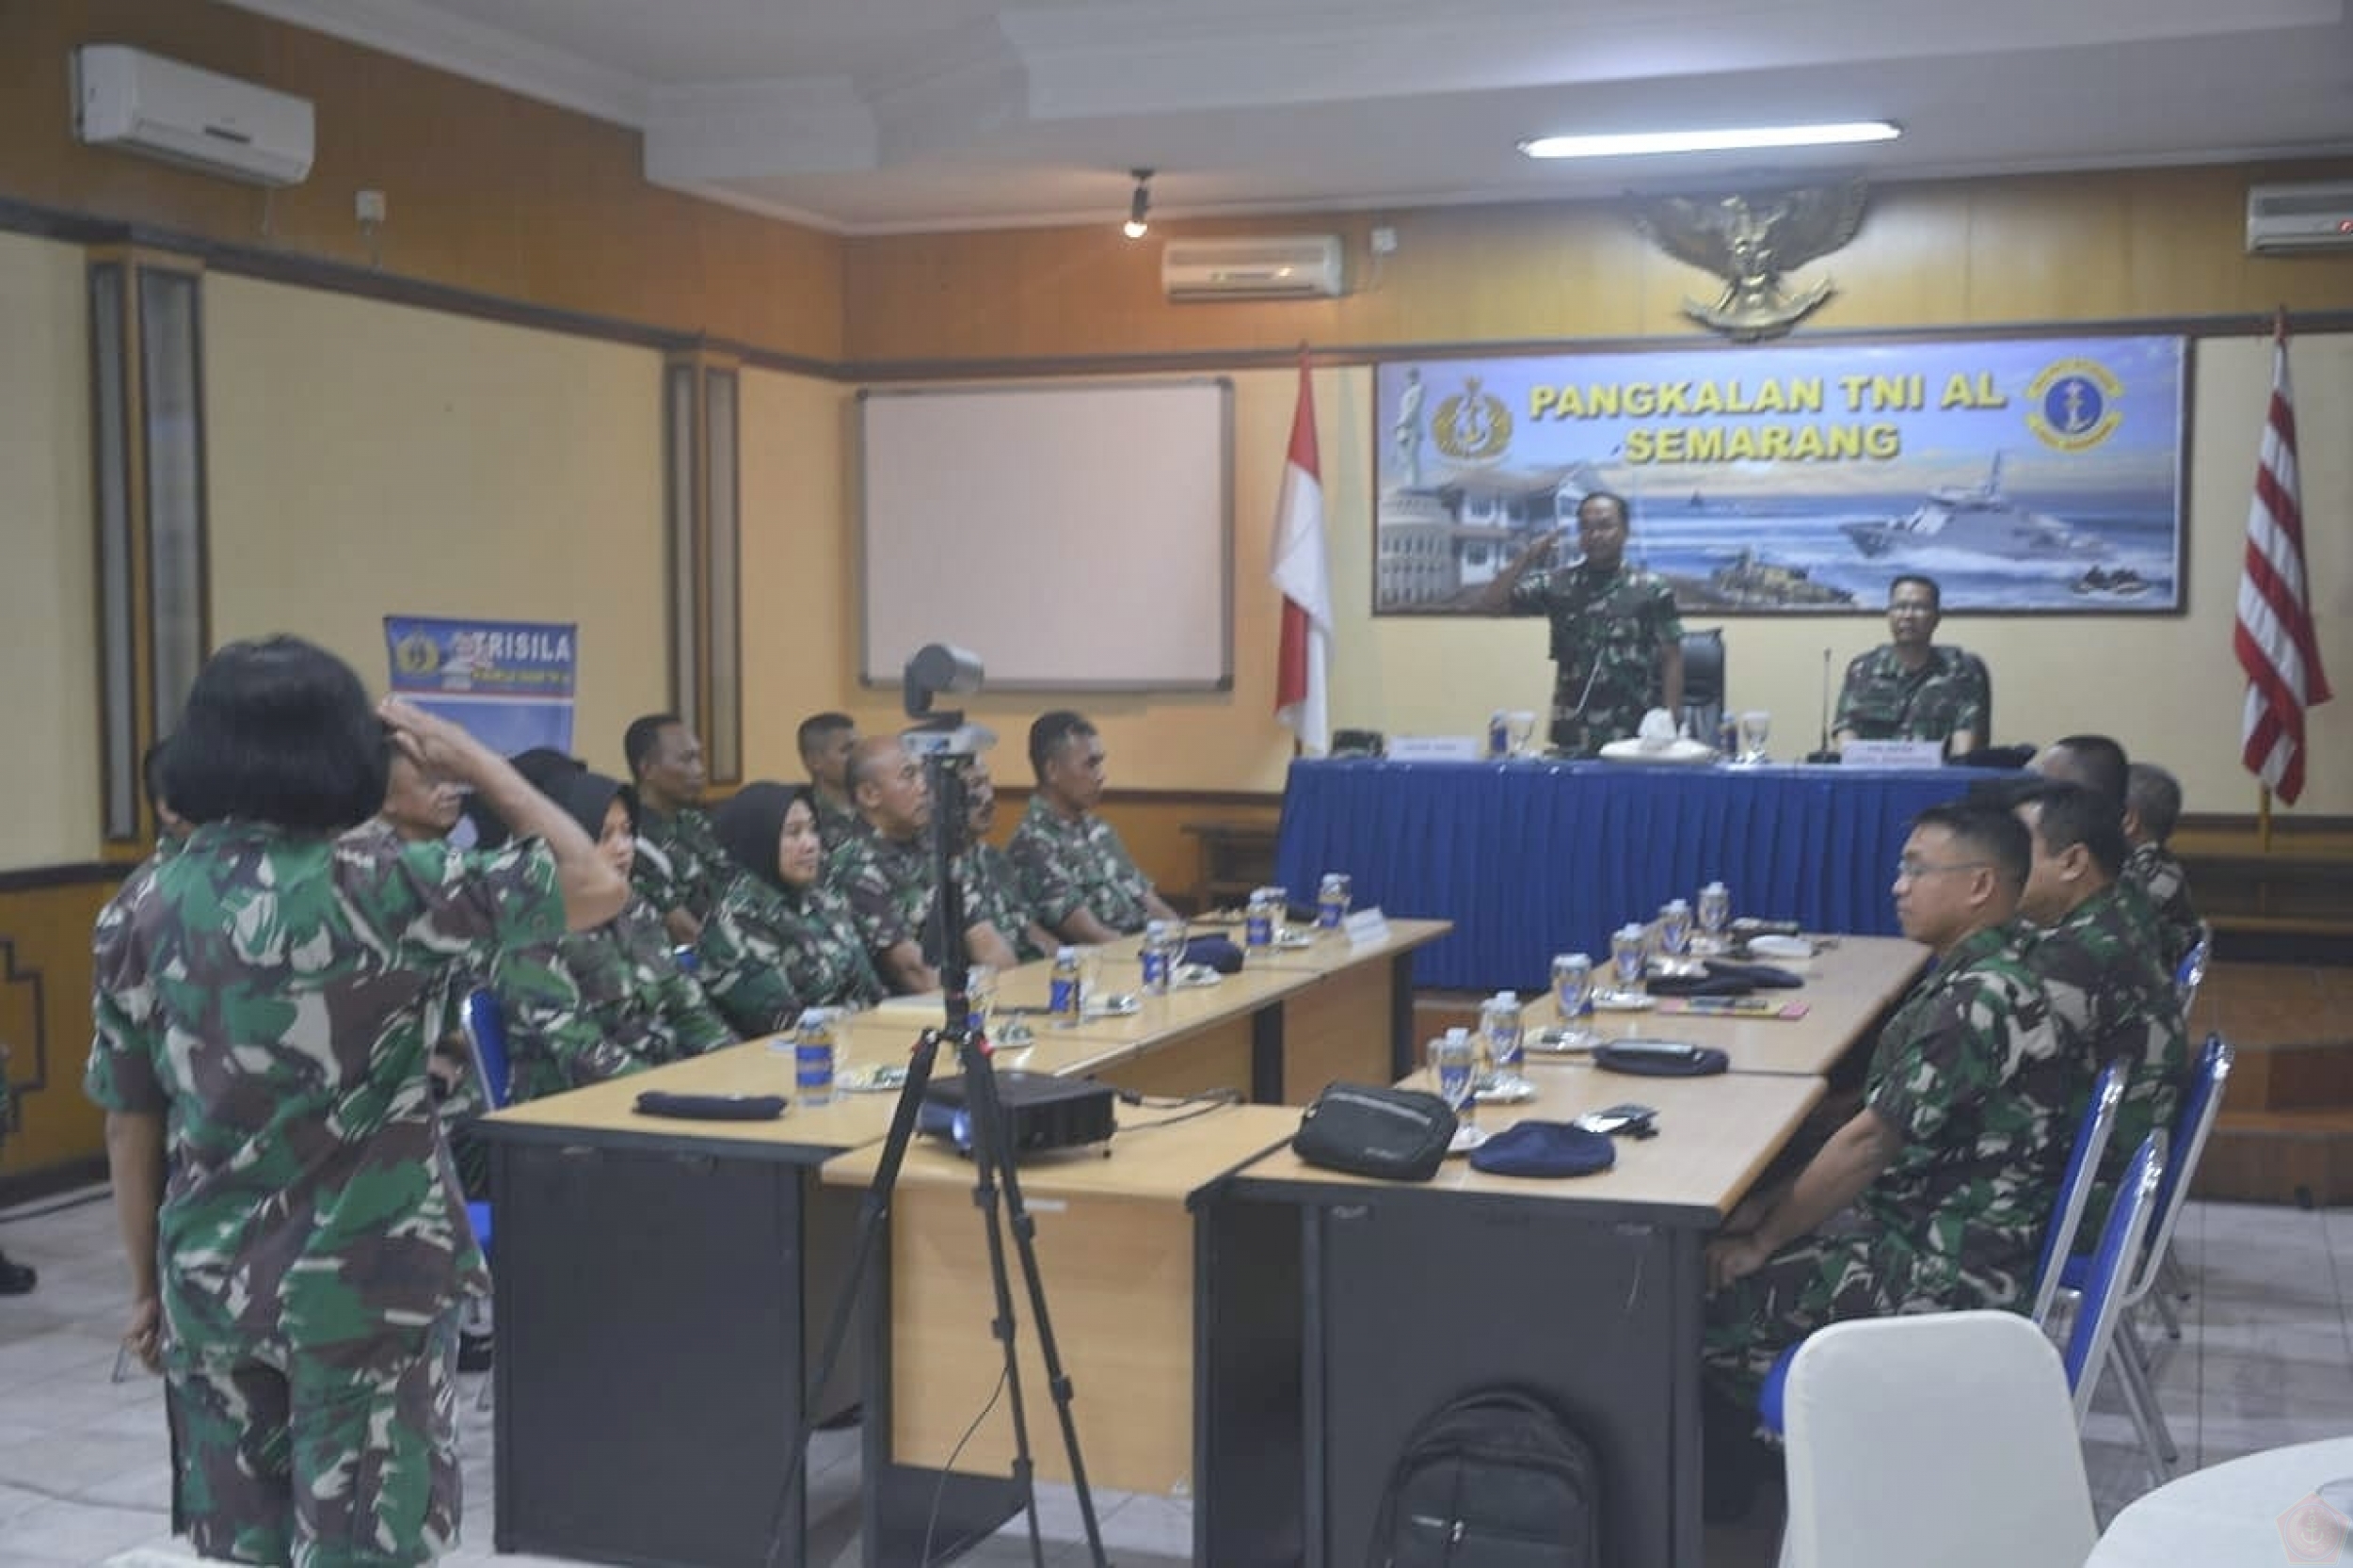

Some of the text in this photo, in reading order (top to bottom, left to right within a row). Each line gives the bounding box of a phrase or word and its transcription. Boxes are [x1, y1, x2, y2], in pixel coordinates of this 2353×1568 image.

[1529, 378, 1823, 421] PANGKALAN
[1838, 373, 1925, 412] TNI
[1939, 370, 2009, 409] AL
[1625, 422, 1900, 464] SEMARANG
